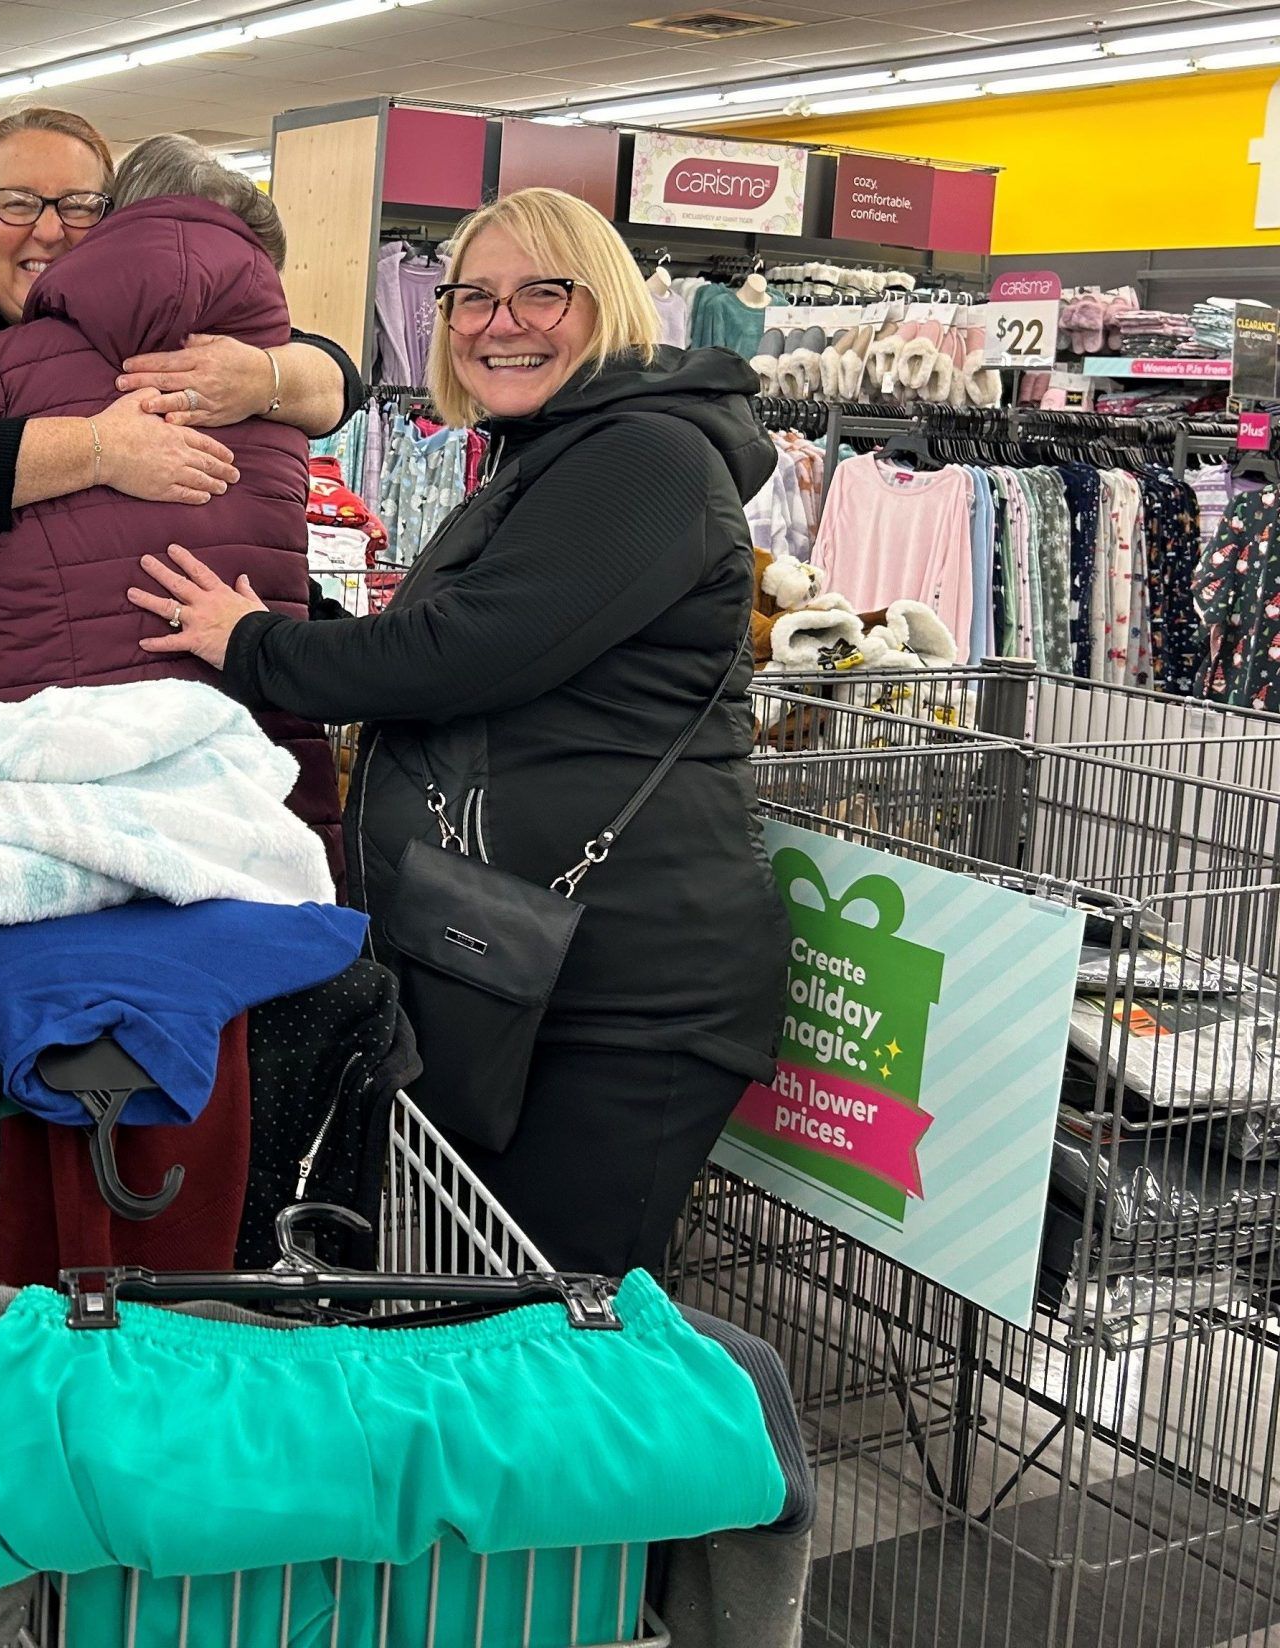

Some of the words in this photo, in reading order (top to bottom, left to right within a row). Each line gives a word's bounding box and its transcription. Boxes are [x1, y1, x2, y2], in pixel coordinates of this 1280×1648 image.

[853, 175, 878, 190] cozy.
[851, 191, 913, 210] comfortable.
[850, 208, 899, 224] confident.
[996, 314, 1044, 356] $22
[1236, 317, 1276, 333] CLEARANCE
[790, 936, 866, 986] Create
[771, 1069, 803, 1102] ith
[809, 1078, 879, 1125] lower
[775, 1104, 853, 1151] prices.
